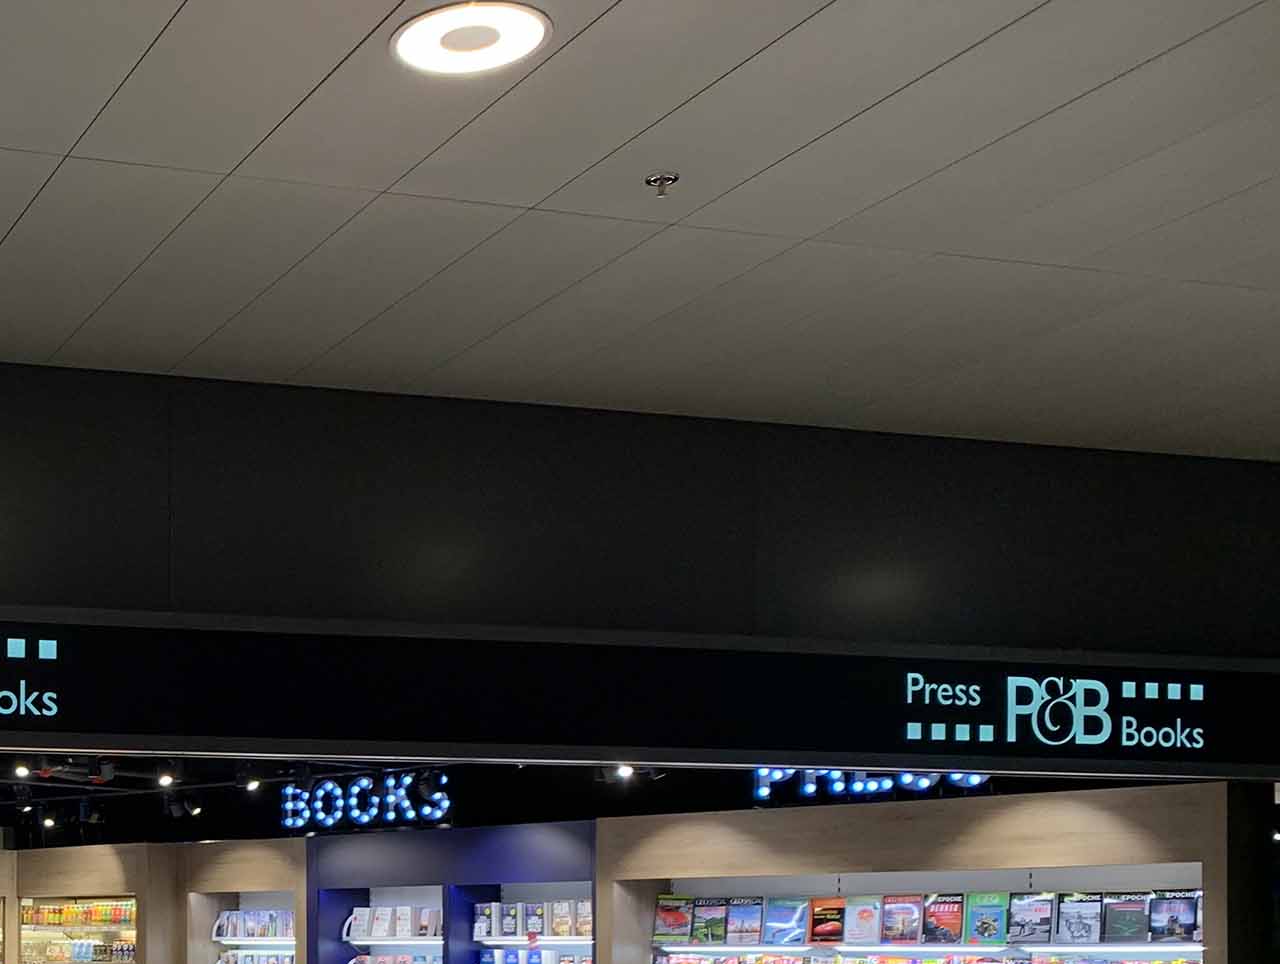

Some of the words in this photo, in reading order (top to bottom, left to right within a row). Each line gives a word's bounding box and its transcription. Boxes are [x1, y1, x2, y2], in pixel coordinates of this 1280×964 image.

[907, 673, 981, 706] Press
[1007, 676, 1112, 745] P&B
[1121, 716, 1204, 748] Books
[282, 774, 451, 828] BOOKS
